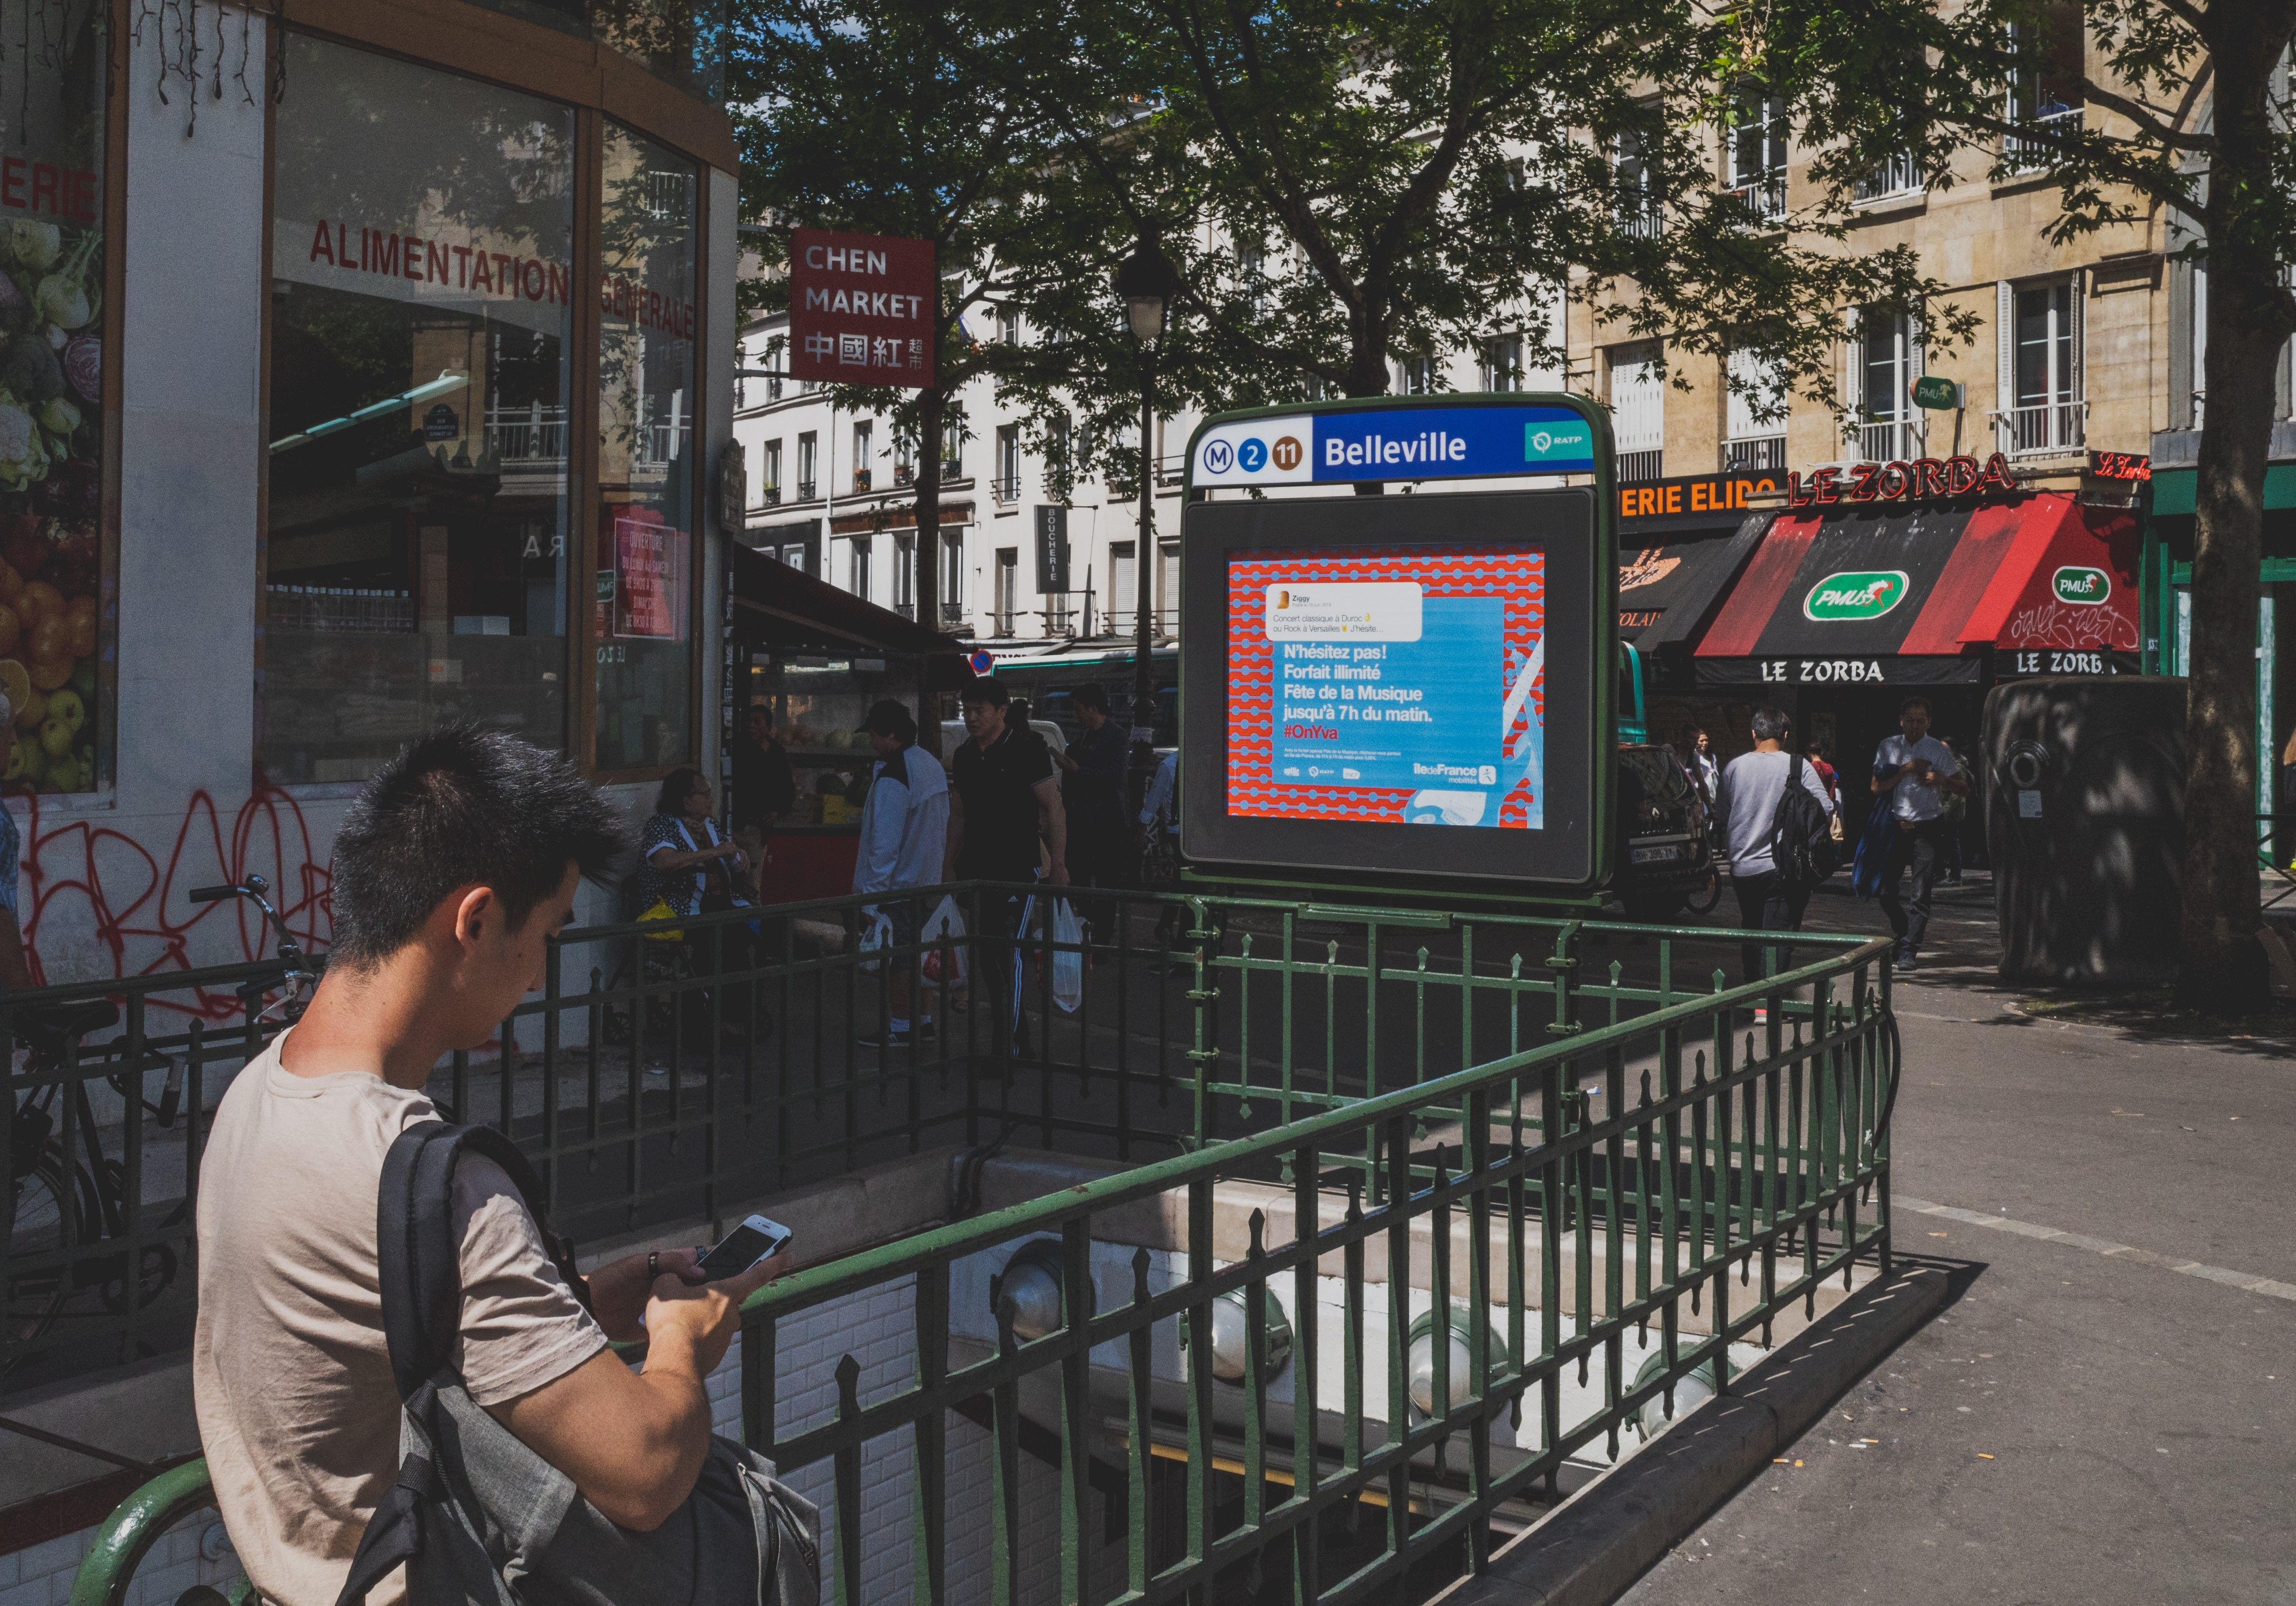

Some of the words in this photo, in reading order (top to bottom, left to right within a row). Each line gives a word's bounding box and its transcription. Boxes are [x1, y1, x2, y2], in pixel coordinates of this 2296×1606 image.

[310, 219, 569, 306] ALIMENTATION
[805, 245, 886, 275] CHEN
[806, 286, 923, 320] MARKET
[804, 331, 902, 368] 中國紅
[909, 338, 923, 370] 超市
[1918, 386, 1941, 399] PMU
[1247, 445, 1258, 465] 2
[1276, 443, 1296, 464] 11
[1325, 431, 1466, 467] Belleville
[1554, 436, 1582, 444] RATP
[2095, 451, 2114, 477] Le
[1788, 467, 1842, 507] LE
[1850, 452, 2016, 502] ZORBA
[1048, 509, 1057, 581] BOUCHERIE
[2059, 579, 2088, 593] PMU
[1815, 589, 1862, 607] PMU
[1302, 615, 1334, 624] classique
[1309, 625, 1340, 633] Versailles
[1284, 643, 1349, 660] N'hésitez
[1284, 664, 1331, 679] Forfait
[1334, 664, 1381, 680] illimité
[1762, 661, 1787, 682] LE
[1800, 661, 1885, 682] ZORBA
[2017, 652, 2040, 672] LE
[2050, 652, 2118, 674] ZORB
[1284, 684, 1315, 699] Fête
[1318, 685, 1338, 700] de
[1341, 685, 1354, 700] la
[1358, 685, 1423, 704] Musique
[1283, 704, 1335, 722] jusqu'à
[1362, 706, 1382, 721] du
[1385, 707, 1432, 722] matin.
[1284, 725, 1338, 740] #OnYva
